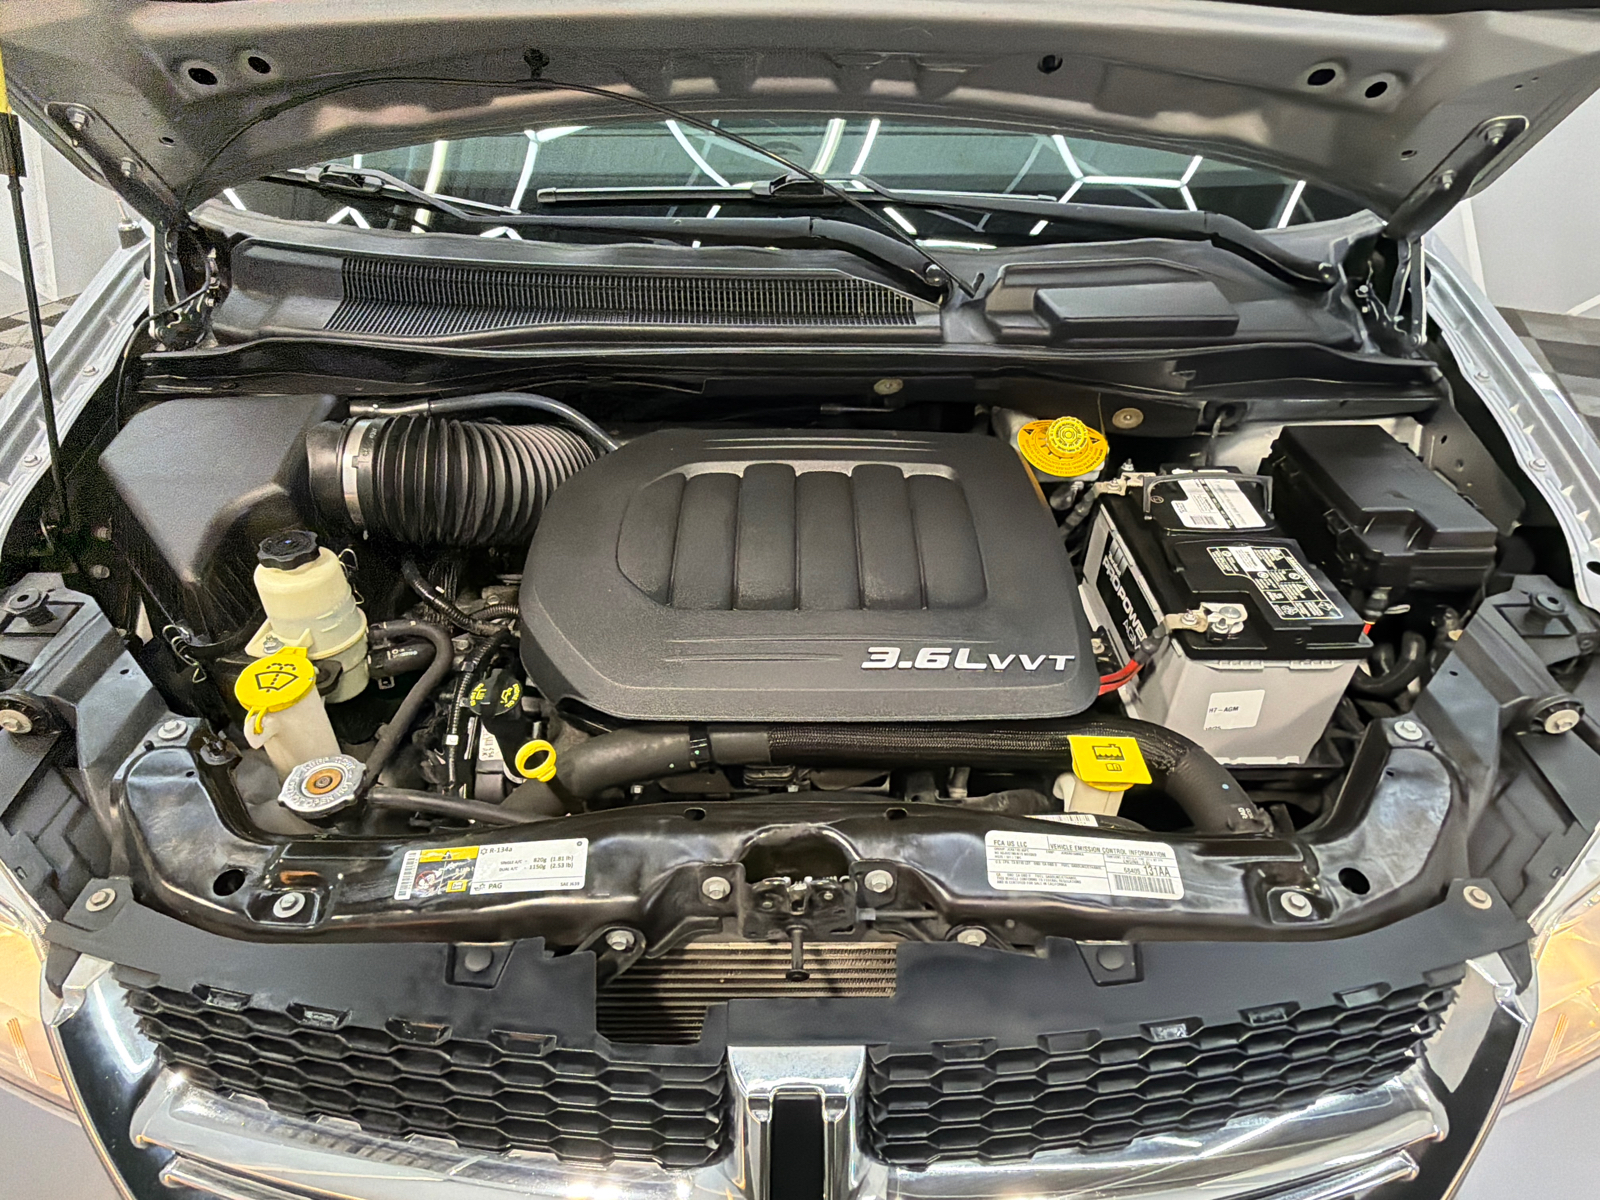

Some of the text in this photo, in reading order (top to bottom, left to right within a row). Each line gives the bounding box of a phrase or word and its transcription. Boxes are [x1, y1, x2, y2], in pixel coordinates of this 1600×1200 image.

[489, 846, 513, 854] R-134a
[1049, 843, 1073, 851] VEHICLE
[1074, 845, 1101, 853] EMISSION
[1101, 847, 1127, 855] CONTROL
[1128, 849, 1167, 858] INFORMATION
[488, 882, 503, 890] PAG
